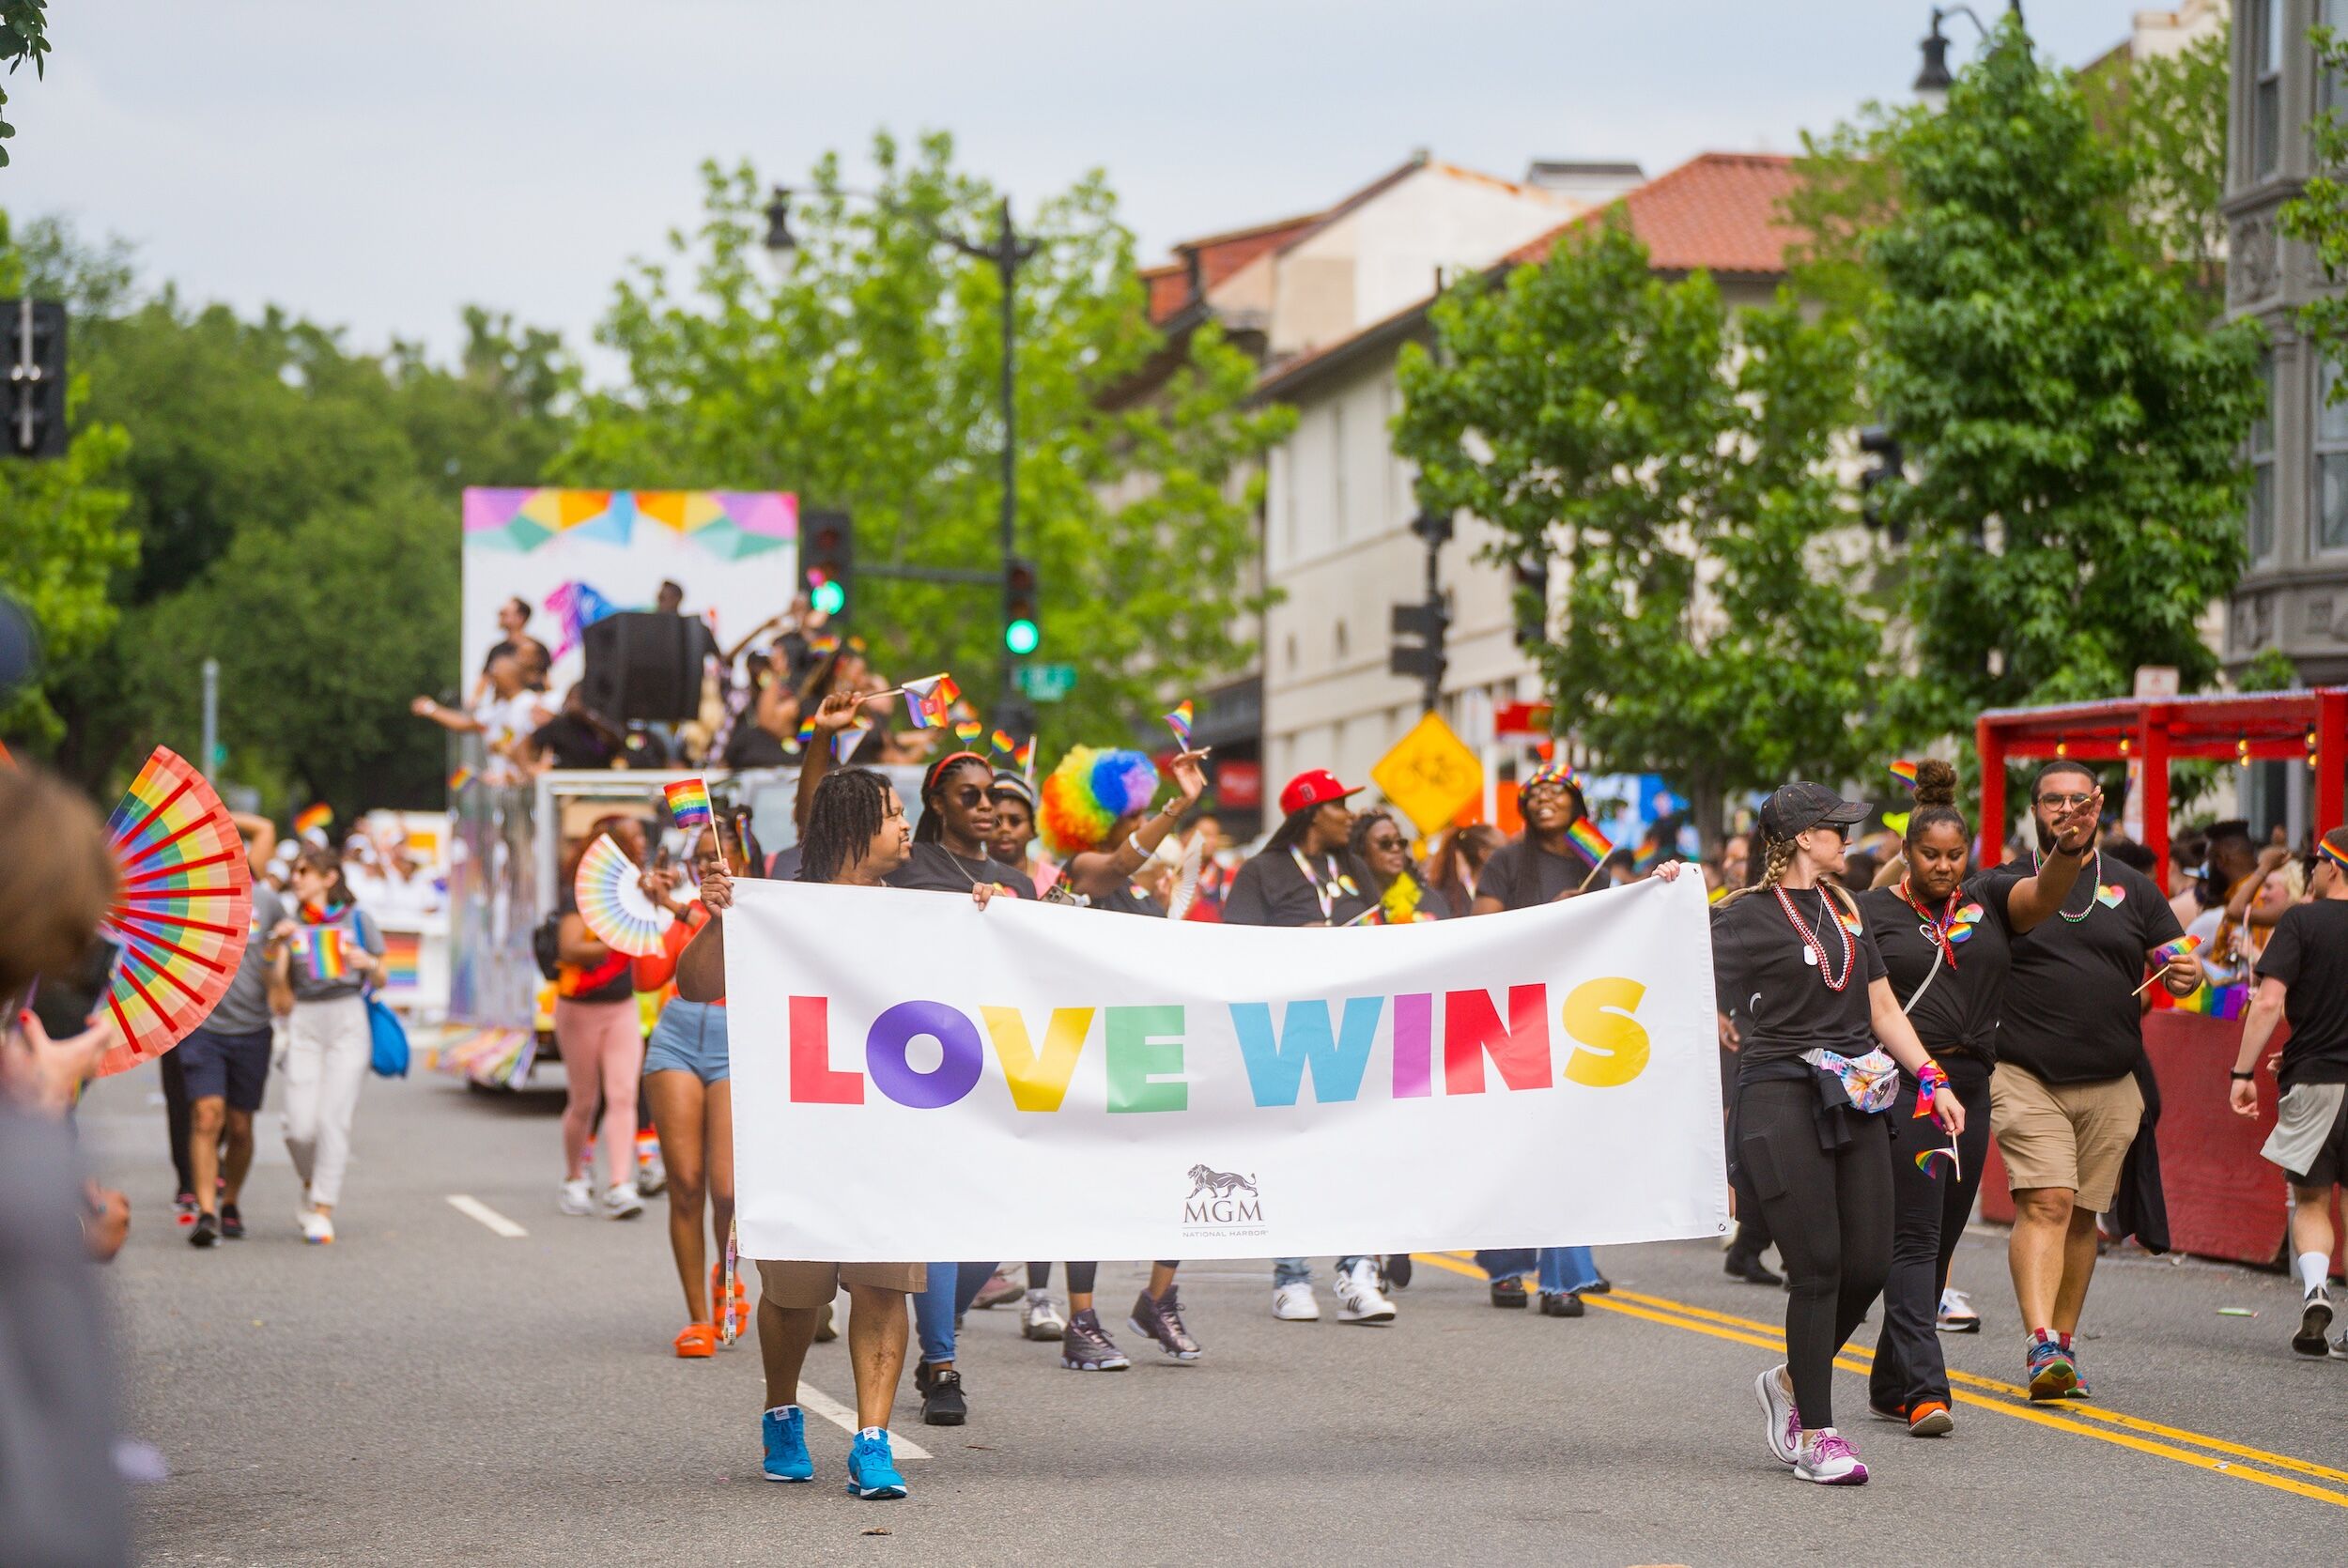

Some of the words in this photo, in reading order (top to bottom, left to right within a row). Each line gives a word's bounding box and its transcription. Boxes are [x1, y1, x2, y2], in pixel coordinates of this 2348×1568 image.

[788, 995, 1188, 1114] LOVE
[1228, 976, 1651, 1107] WINS
[1182, 1200, 1263, 1223] MGM
